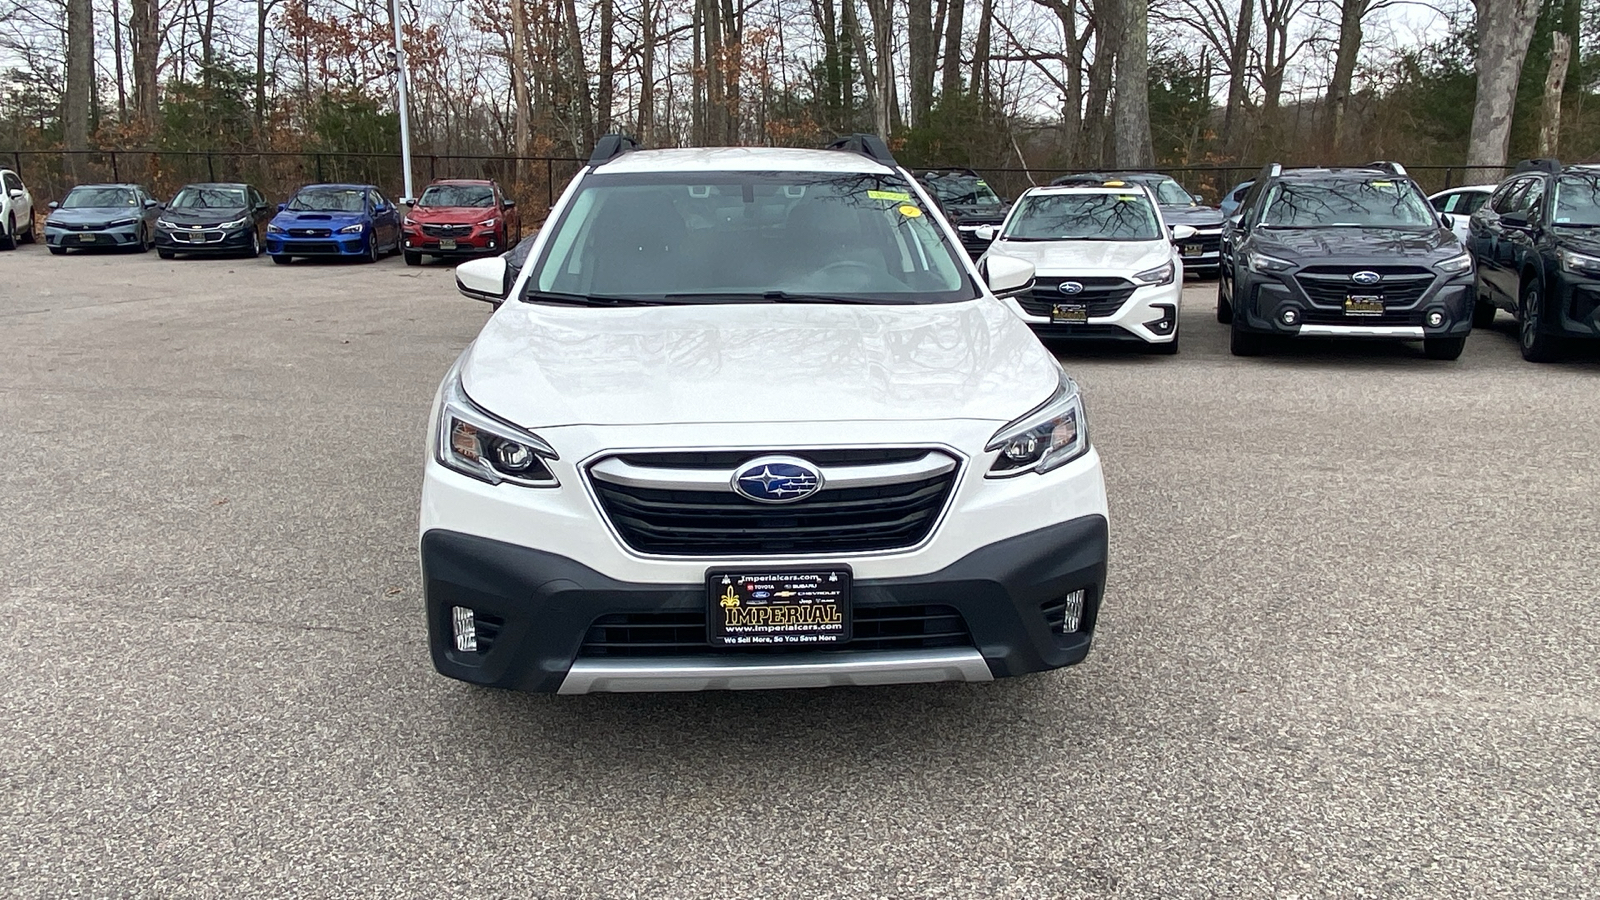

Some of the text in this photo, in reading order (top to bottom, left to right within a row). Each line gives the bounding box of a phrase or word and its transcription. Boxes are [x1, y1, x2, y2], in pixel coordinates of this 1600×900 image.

[741, 574, 819, 583] Imperialcars.com
[725, 604, 842, 626] IMPERIAL
[724, 634, 837, 644] We Sell More, So You Save More
